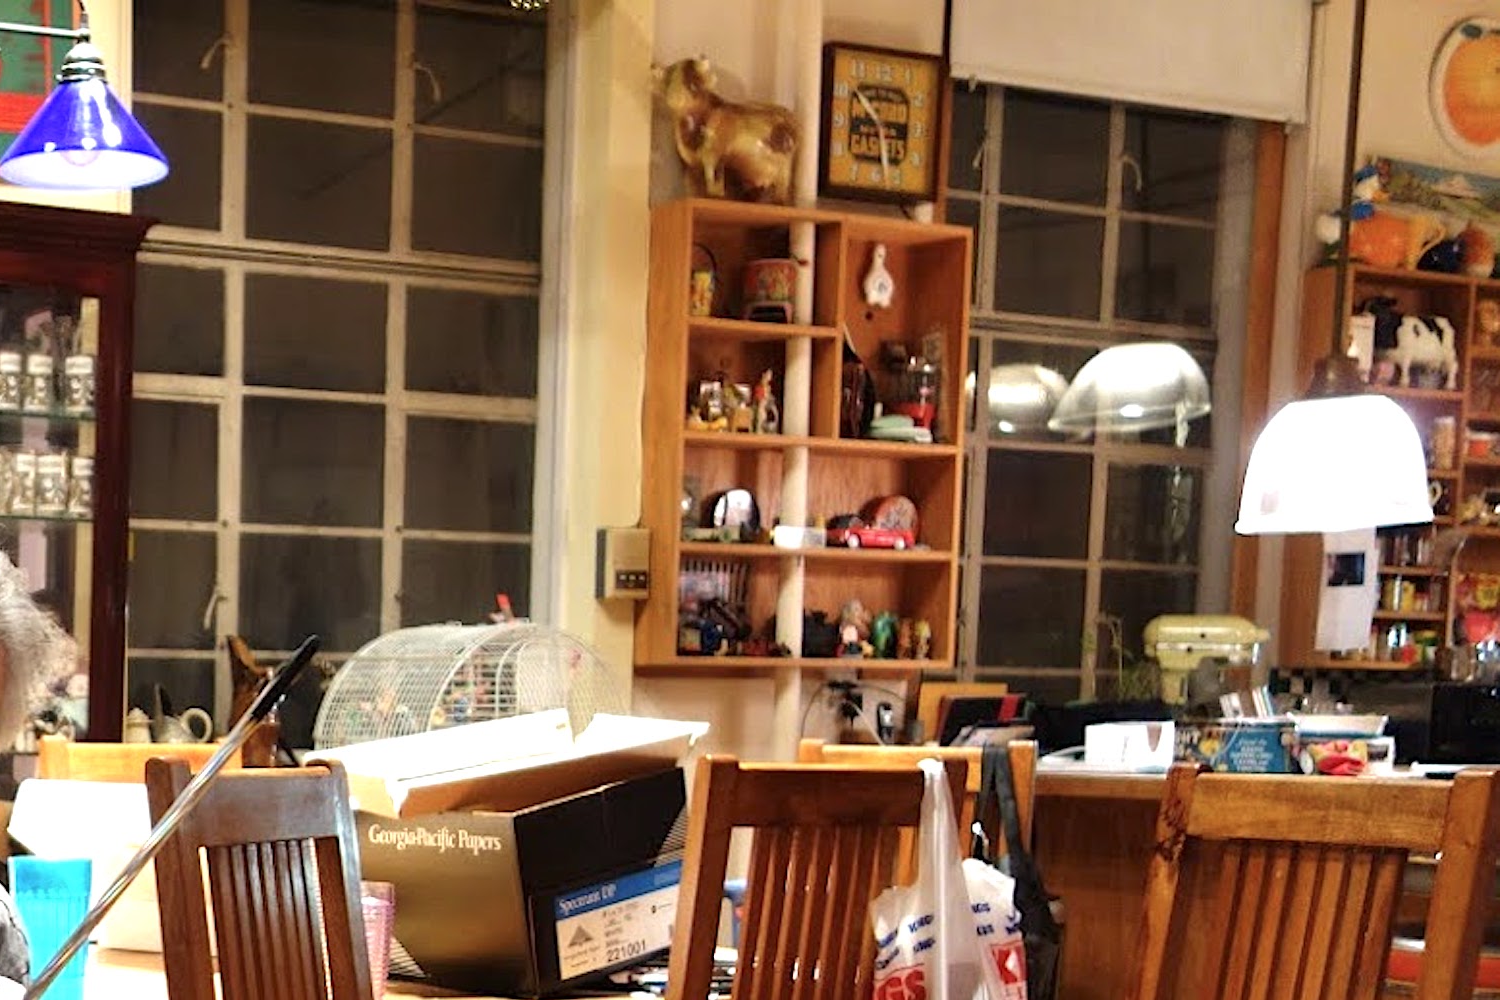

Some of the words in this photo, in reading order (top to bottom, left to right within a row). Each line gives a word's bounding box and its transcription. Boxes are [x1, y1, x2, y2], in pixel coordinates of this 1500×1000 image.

[850, 134, 906, 160] GASETS
[368, 823, 456, 853] Georgia-Pacific
[458, 829, 502, 856] Papers
[606, 940, 647, 962] 221001
